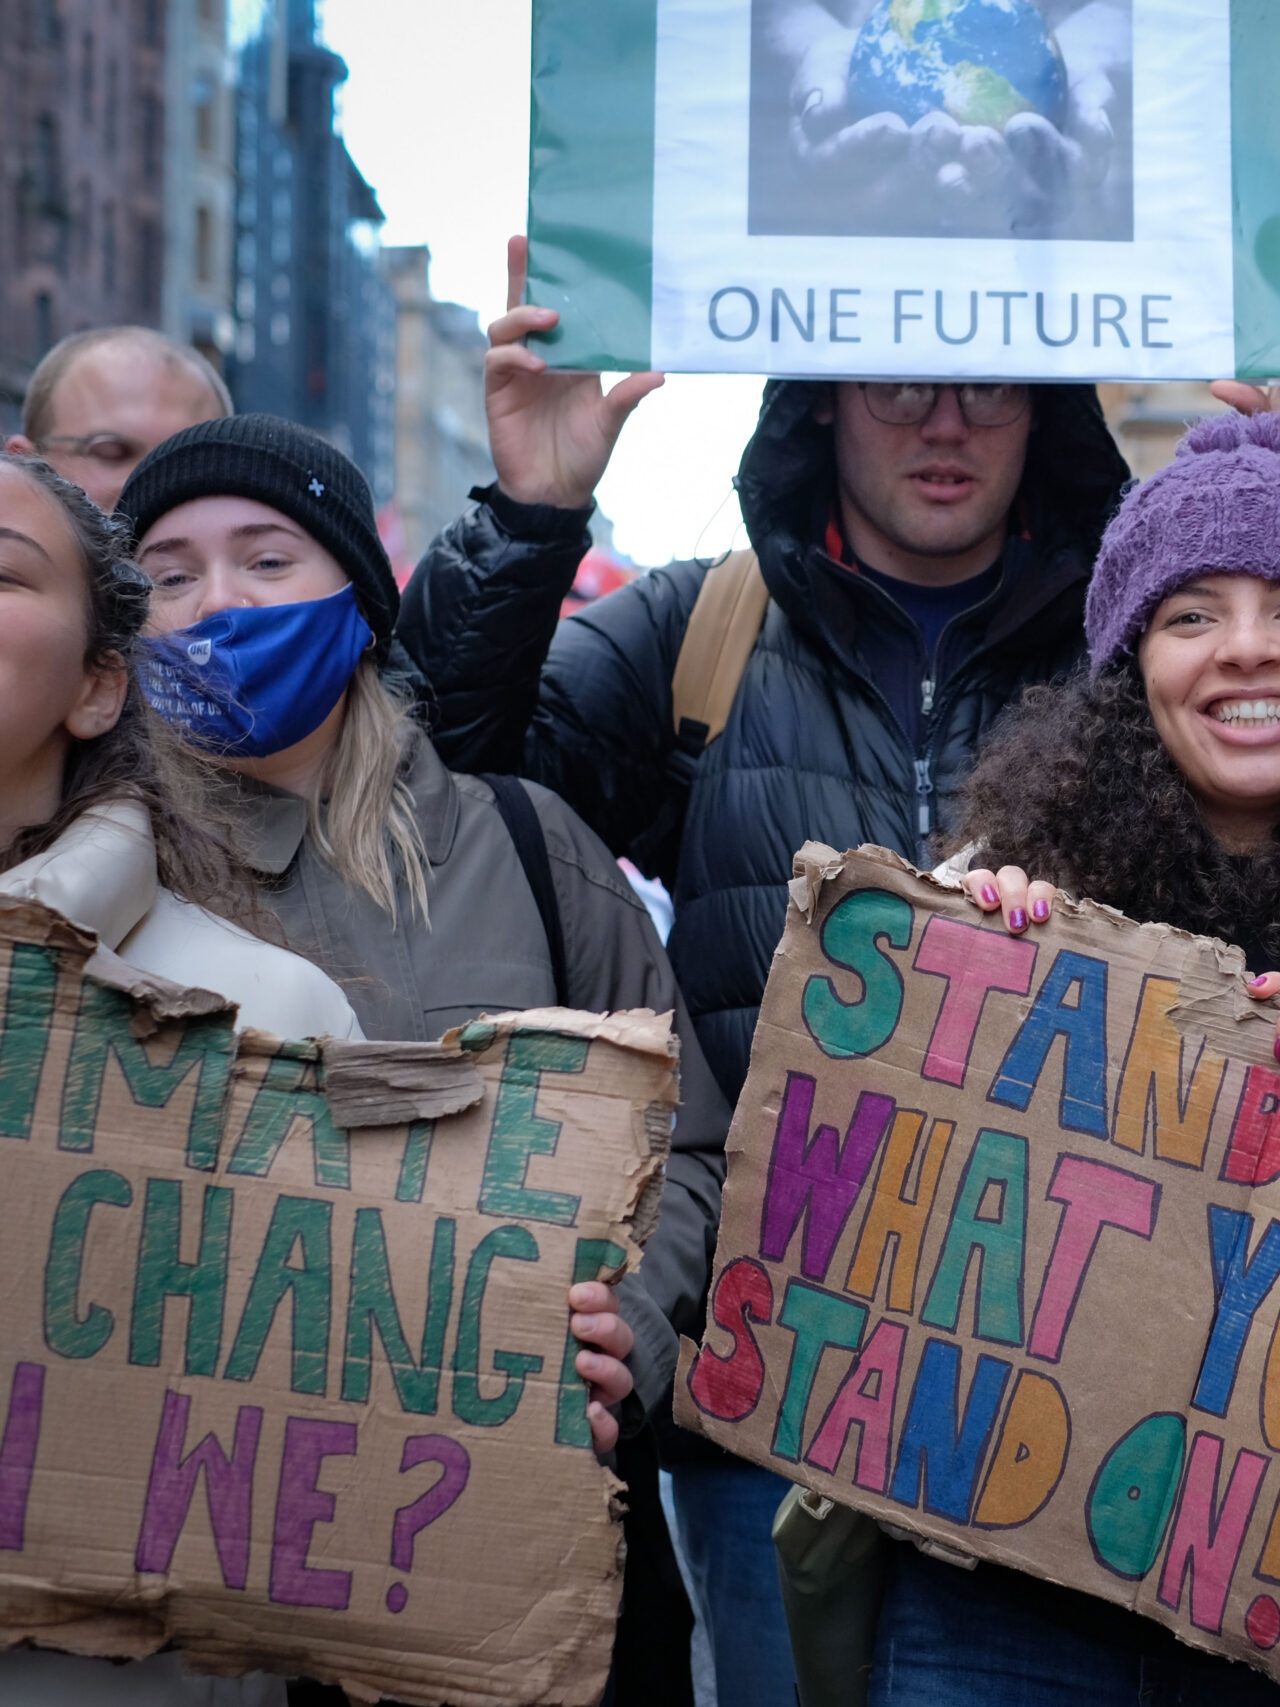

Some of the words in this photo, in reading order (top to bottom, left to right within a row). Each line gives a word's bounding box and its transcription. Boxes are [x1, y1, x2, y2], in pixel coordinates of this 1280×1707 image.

[708, 286, 861, 343] ONE
[893, 289, 1174, 350] FUTURE
[190, 643, 209, 655] ONE
[760, 1071, 1162, 1363] WHAT
[135, 1389, 471, 1614] WE?
[687, 1257, 1072, 1530] STAND
